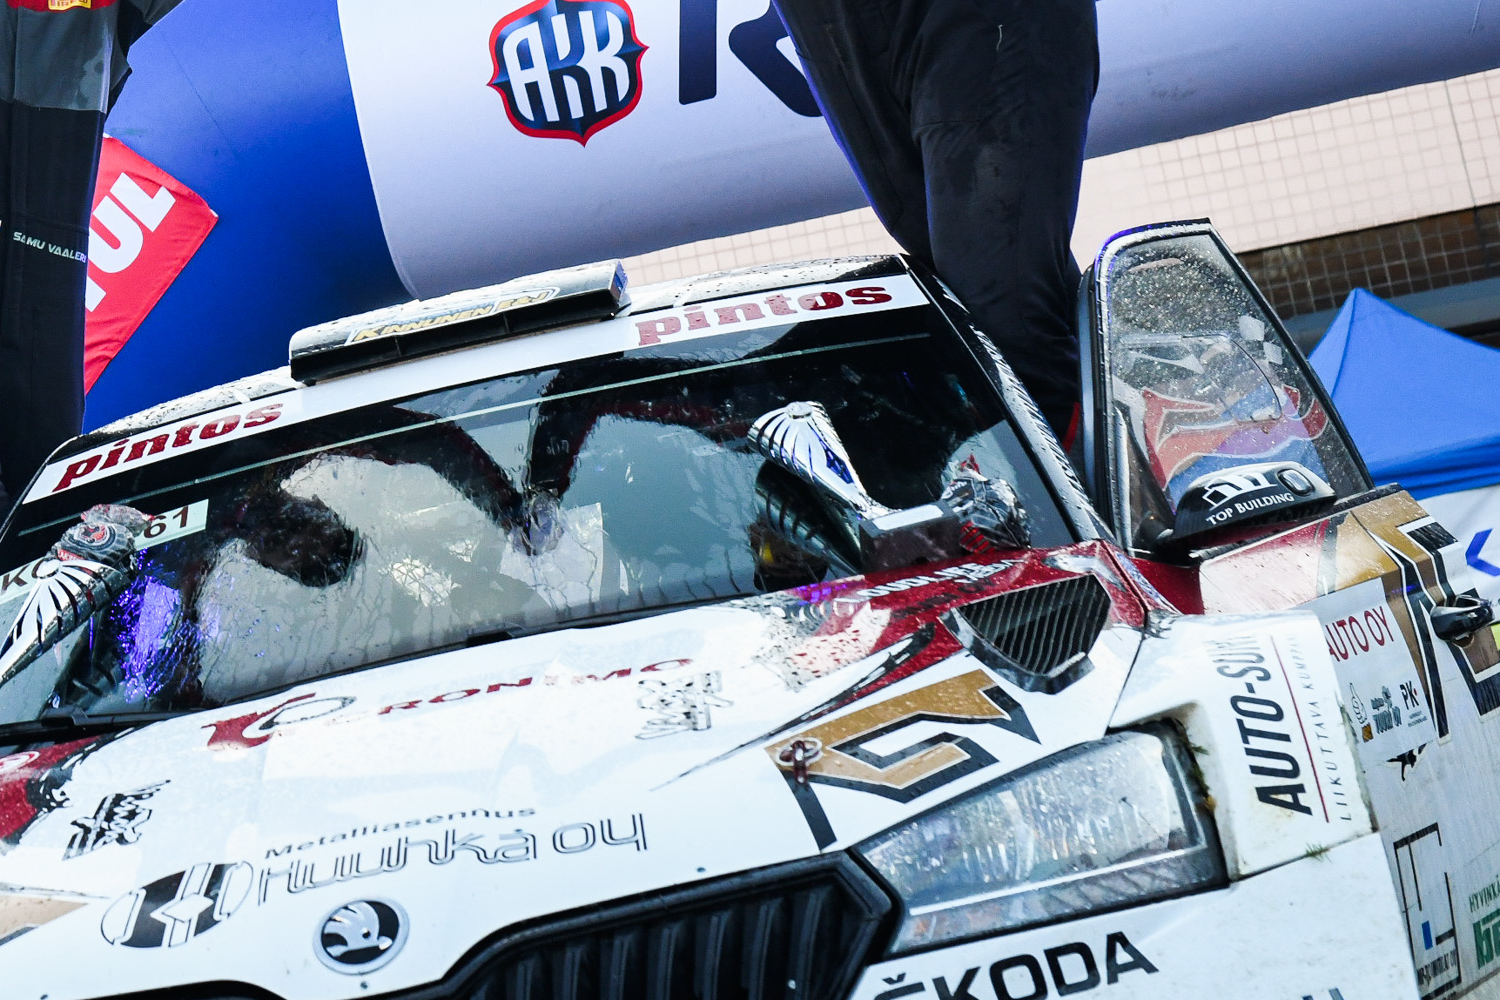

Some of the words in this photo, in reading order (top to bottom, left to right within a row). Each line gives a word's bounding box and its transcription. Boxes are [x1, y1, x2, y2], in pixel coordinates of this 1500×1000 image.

[636, 284, 894, 347] pintos
[51, 401, 285, 493] pintos
[1206, 507, 1232, 526] TOP
[1234, 491, 1294, 516] BUILDING
[1363, 605, 1395, 647] OY
[1308, 701, 1352, 822] LIIKUTTAVA
